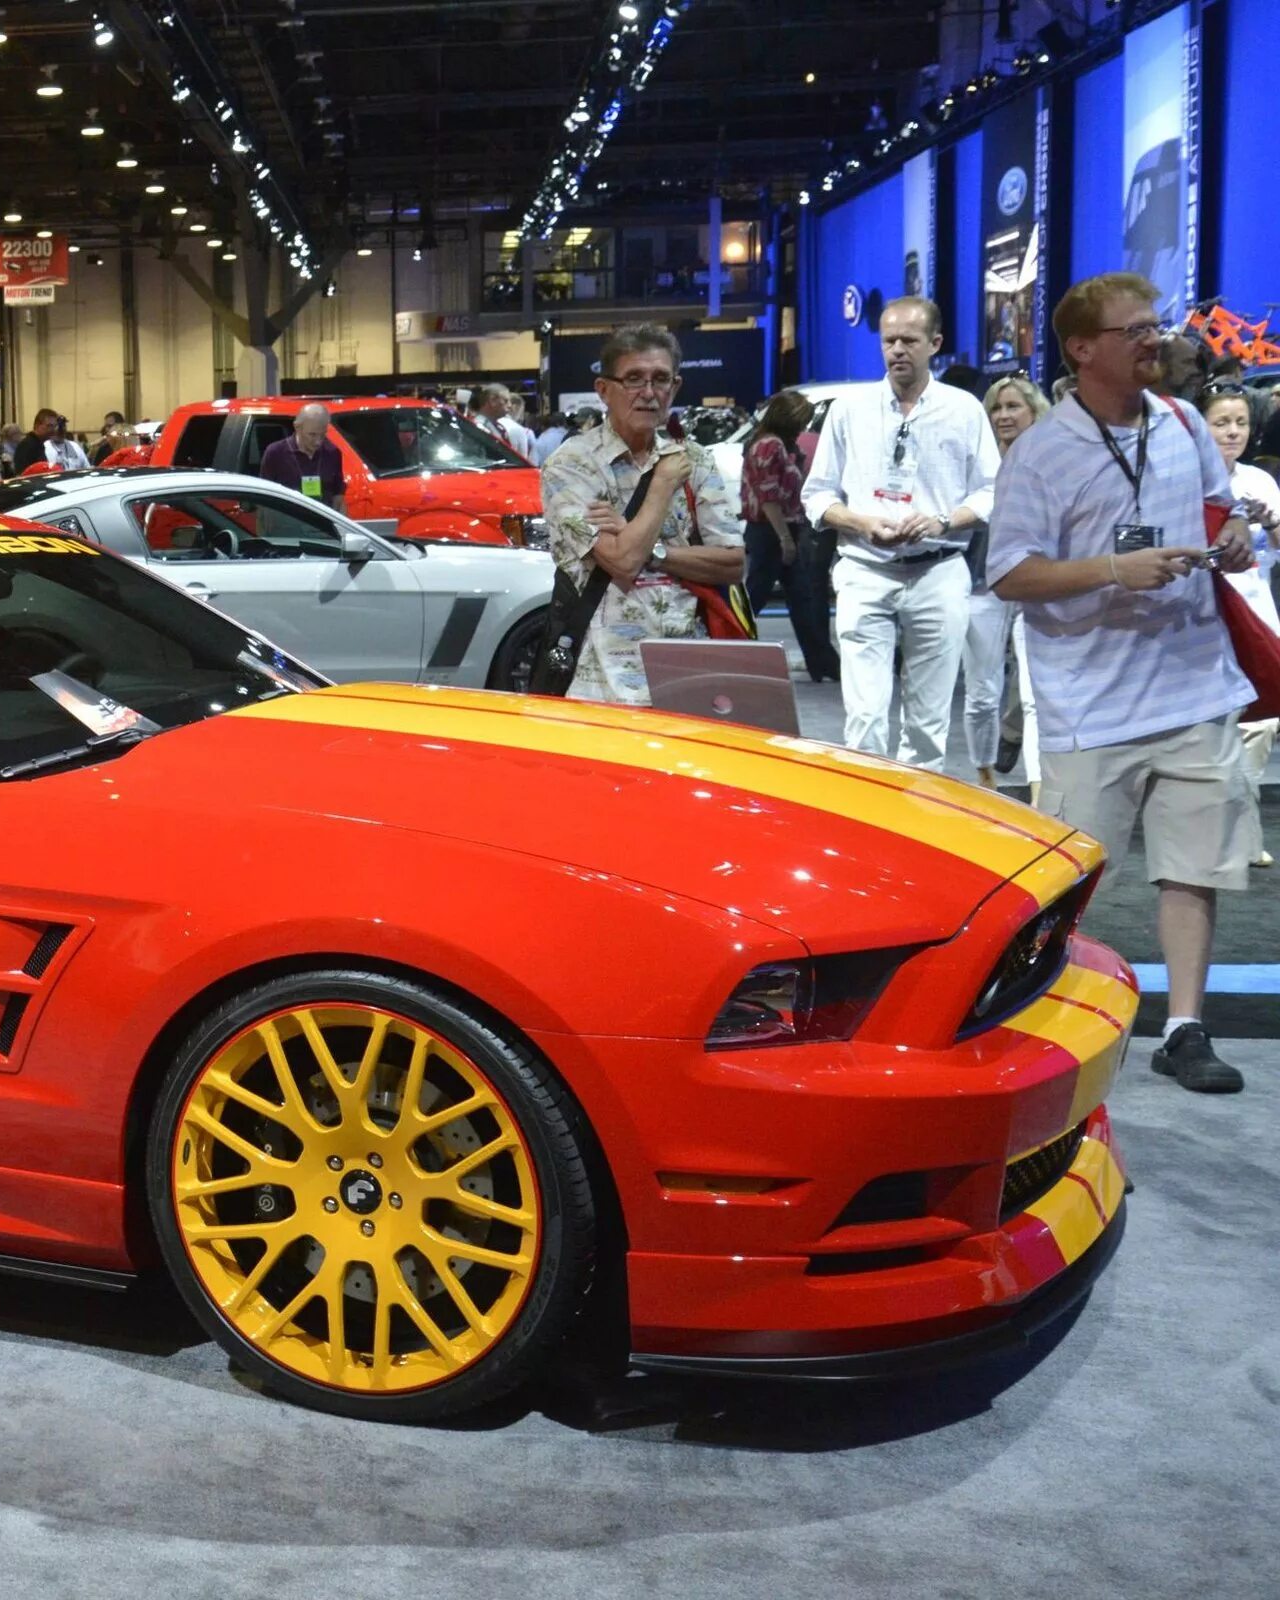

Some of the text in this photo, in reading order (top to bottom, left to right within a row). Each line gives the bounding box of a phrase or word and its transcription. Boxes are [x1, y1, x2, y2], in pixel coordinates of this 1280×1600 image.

[1039, 108, 1049, 212] CHOICE
[1184, 24, 1202, 306] HOOSE ATTITUDE
[2, 240, 52, 257] 22300
[31, 287, 52, 297] TREND
